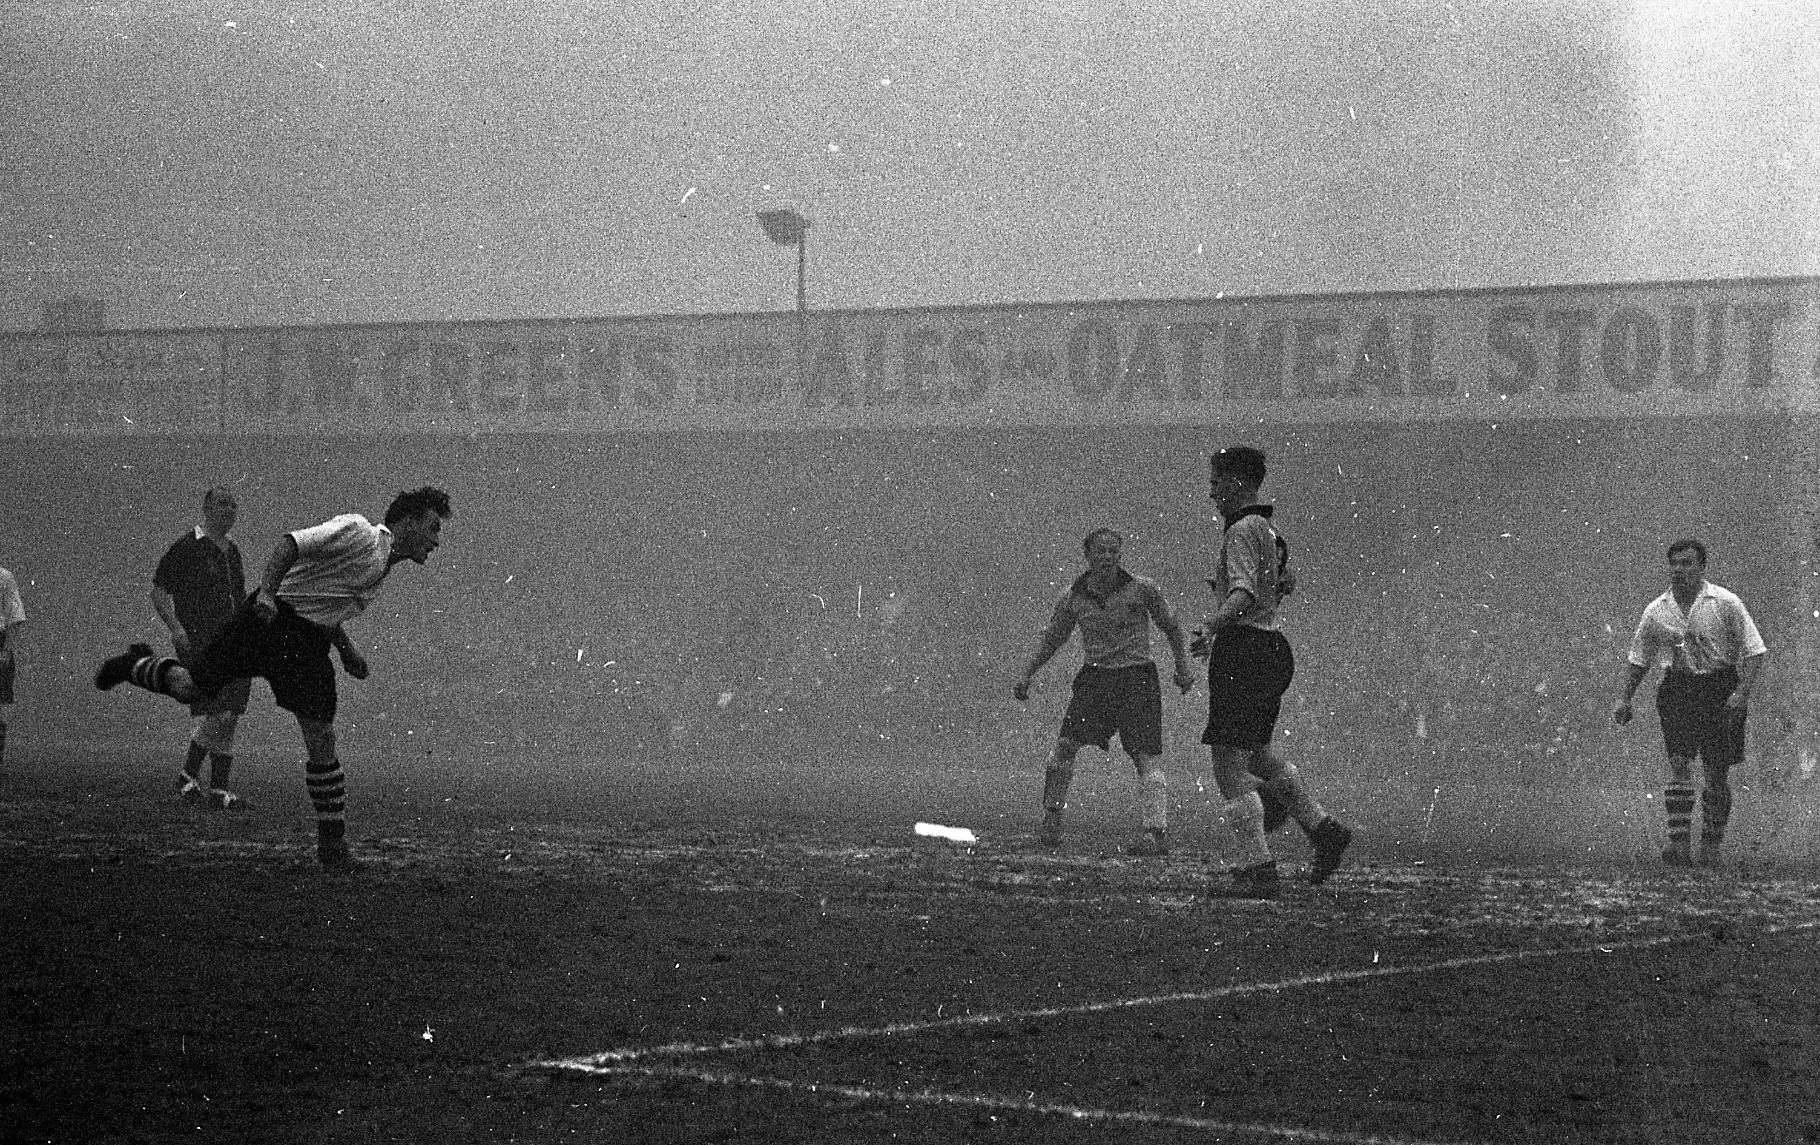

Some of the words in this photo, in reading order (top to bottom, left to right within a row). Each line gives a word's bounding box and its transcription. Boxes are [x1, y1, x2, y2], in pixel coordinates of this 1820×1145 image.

[804, 324, 991, 408] ALES
[1066, 311, 1458, 403] OATMEAL
[1488, 301, 1790, 394] STOUT
